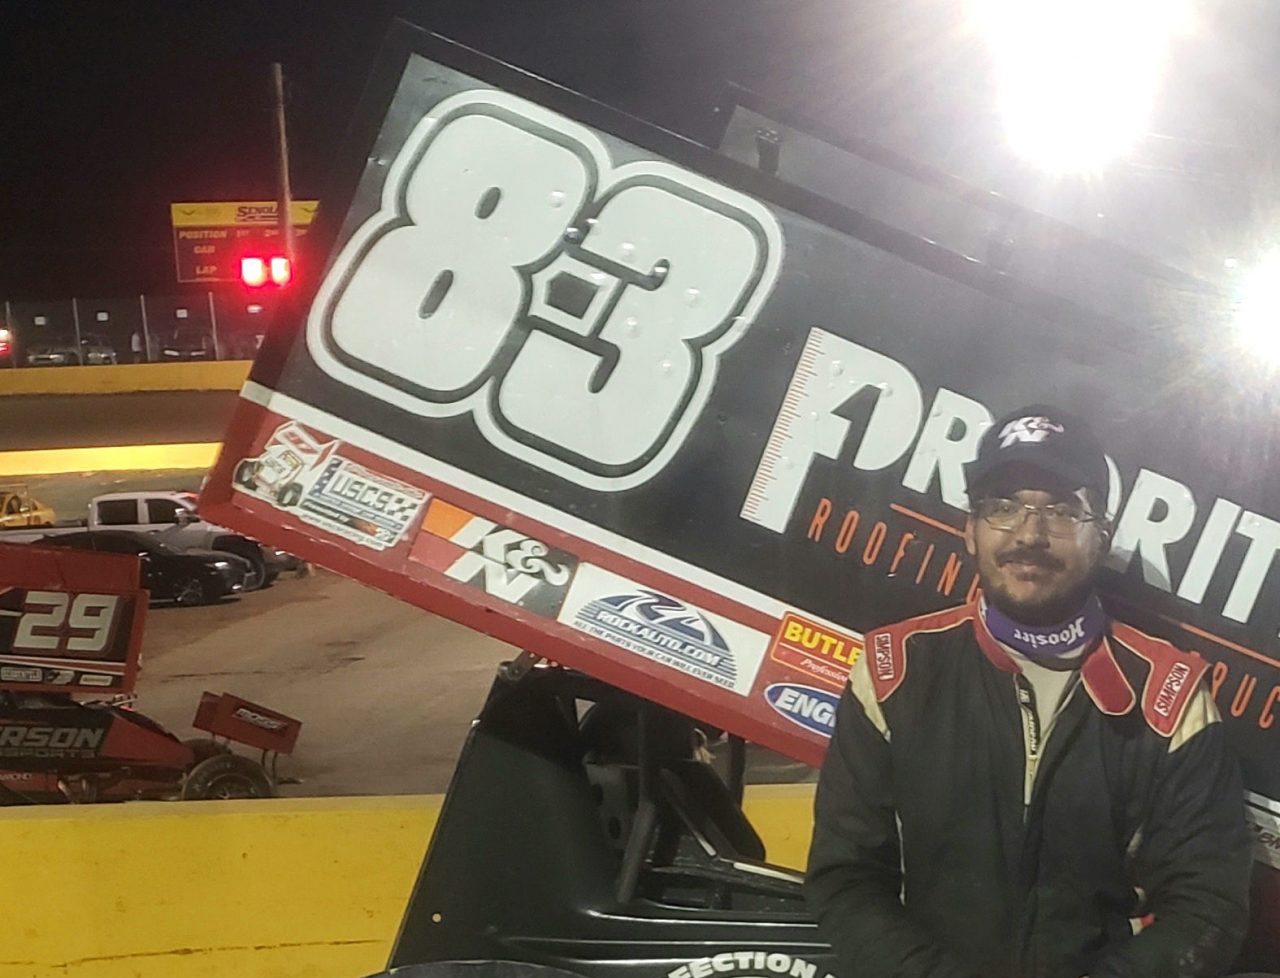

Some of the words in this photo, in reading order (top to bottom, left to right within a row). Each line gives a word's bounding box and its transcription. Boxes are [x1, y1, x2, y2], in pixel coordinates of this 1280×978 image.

[196, 266, 217, 275] LAP
[306, 88, 785, 492] 83
[443, 516, 570, 604] K&N
[14, 590, 120, 651] 29
[595, 609, 723, 668] ROCKAUTO.COM
[783, 621, 865, 666] BUTLE
[1014, 616, 1085, 648] Hoosier
[875, 633, 894, 680] SIMPSON
[774, 687, 836, 727] ENG
[1154, 662, 1191, 716] SIMPSON
[0, 726, 105, 749] RSON
